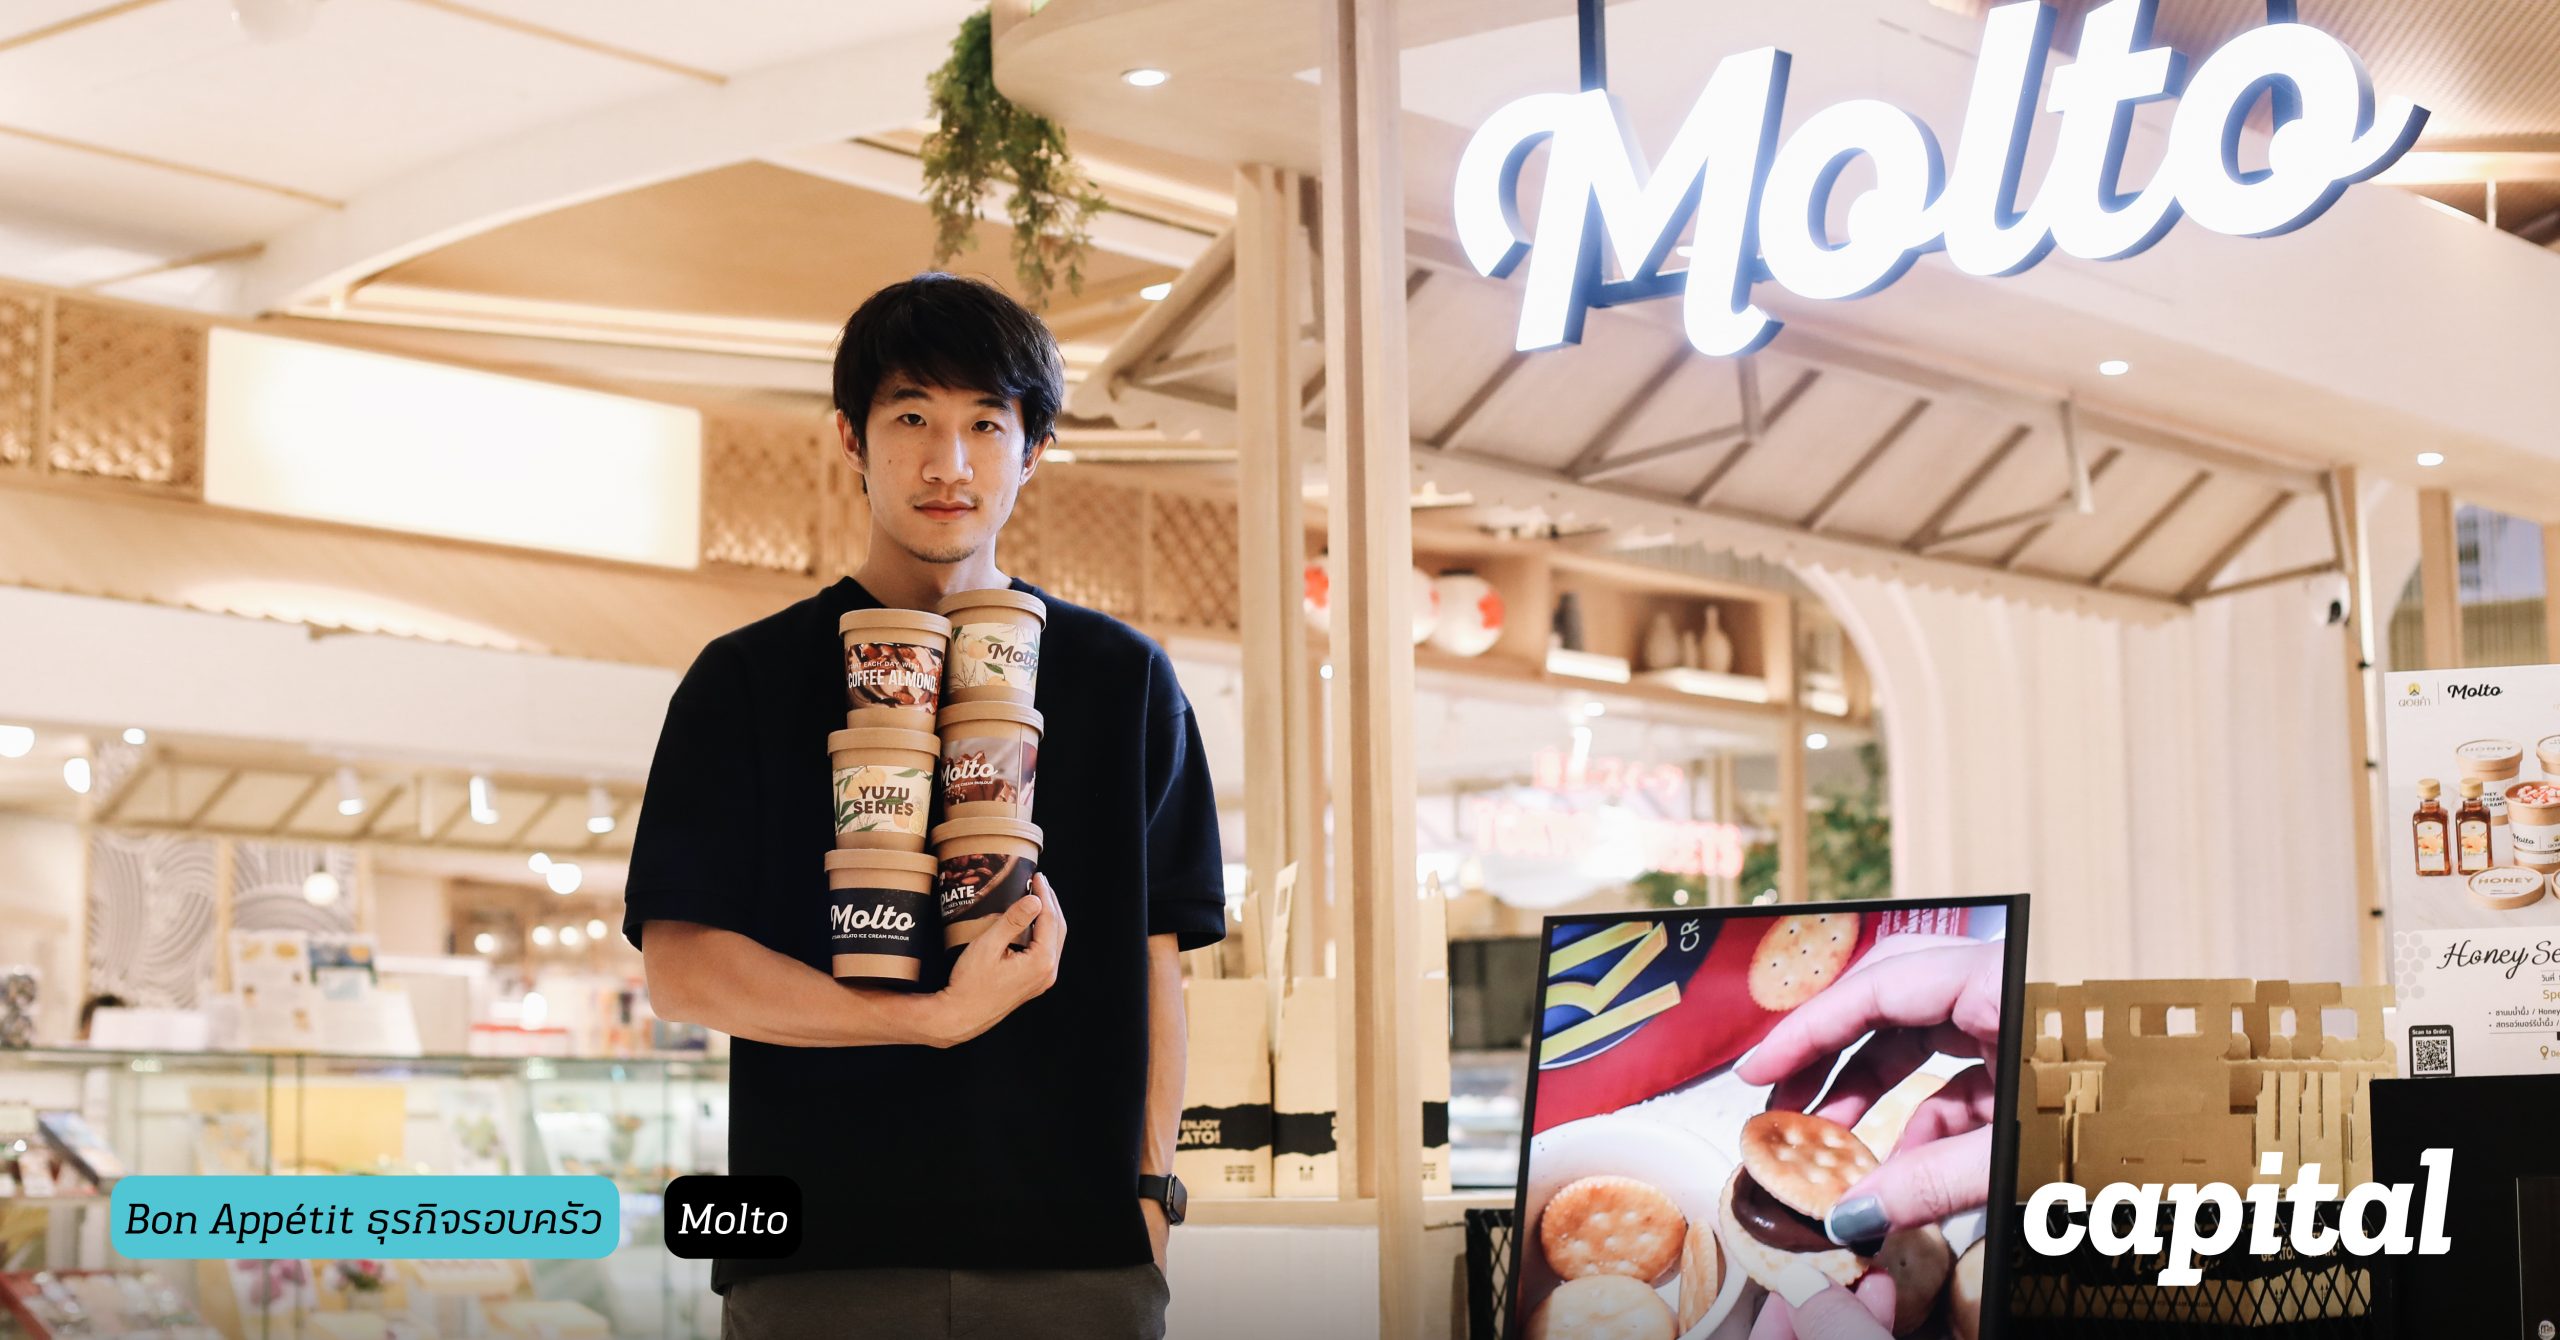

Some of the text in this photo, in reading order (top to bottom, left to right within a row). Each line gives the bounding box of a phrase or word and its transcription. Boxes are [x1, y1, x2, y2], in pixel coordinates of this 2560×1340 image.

[1452, 0, 2431, 356] Molto
[848, 669, 936, 692] COFFEE ALMOND
[2447, 684, 2503, 699] Molto
[858, 786, 910, 801] YUZU
[853, 800, 914, 817] SERIES
[2479, 876, 2534, 885] HONEY
[831, 903, 916, 933] Molto
[2436, 940, 2528, 980] Honey
[1177, 1130, 1221, 1145] ATO!
